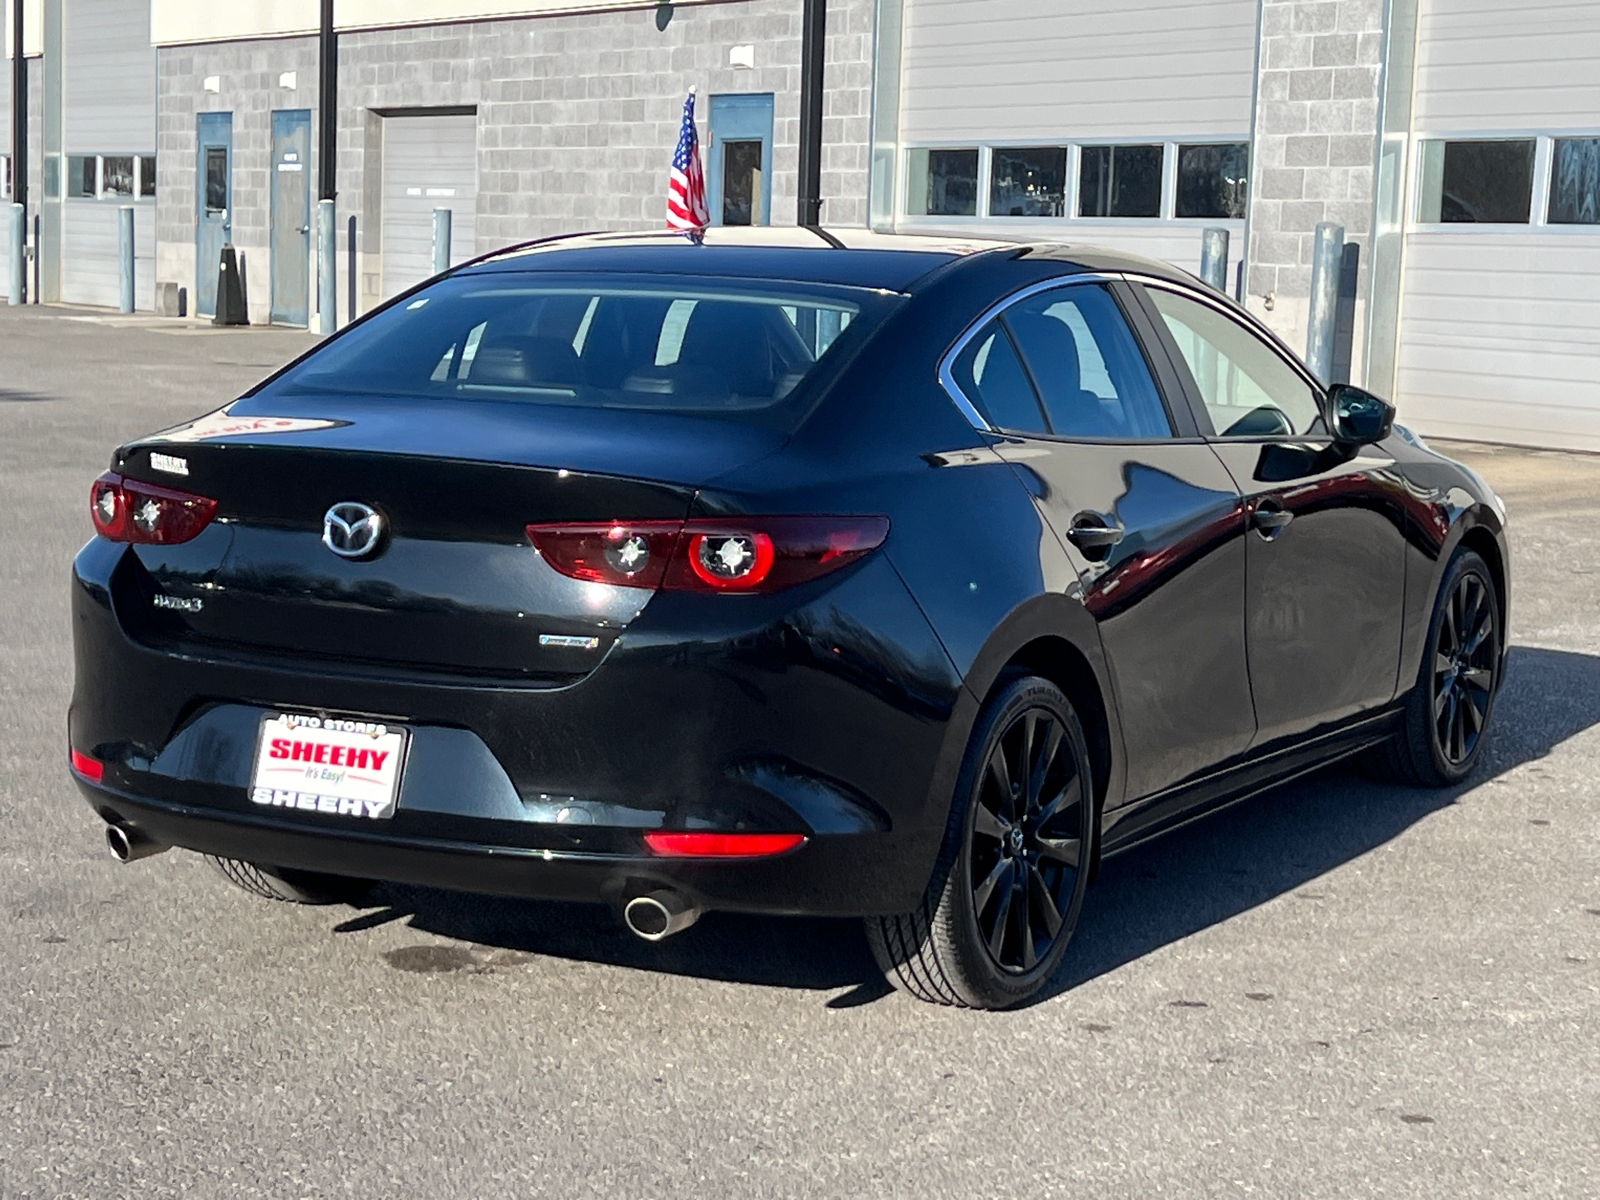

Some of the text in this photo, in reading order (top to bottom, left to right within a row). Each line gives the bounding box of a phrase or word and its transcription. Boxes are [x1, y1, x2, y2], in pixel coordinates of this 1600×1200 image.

[278, 714, 387, 735] AUTO STORES
[269, 738, 389, 770] SHEEHY
[305, 767, 345, 784] It's Easy!
[252, 787, 391, 818] SHEEHY
